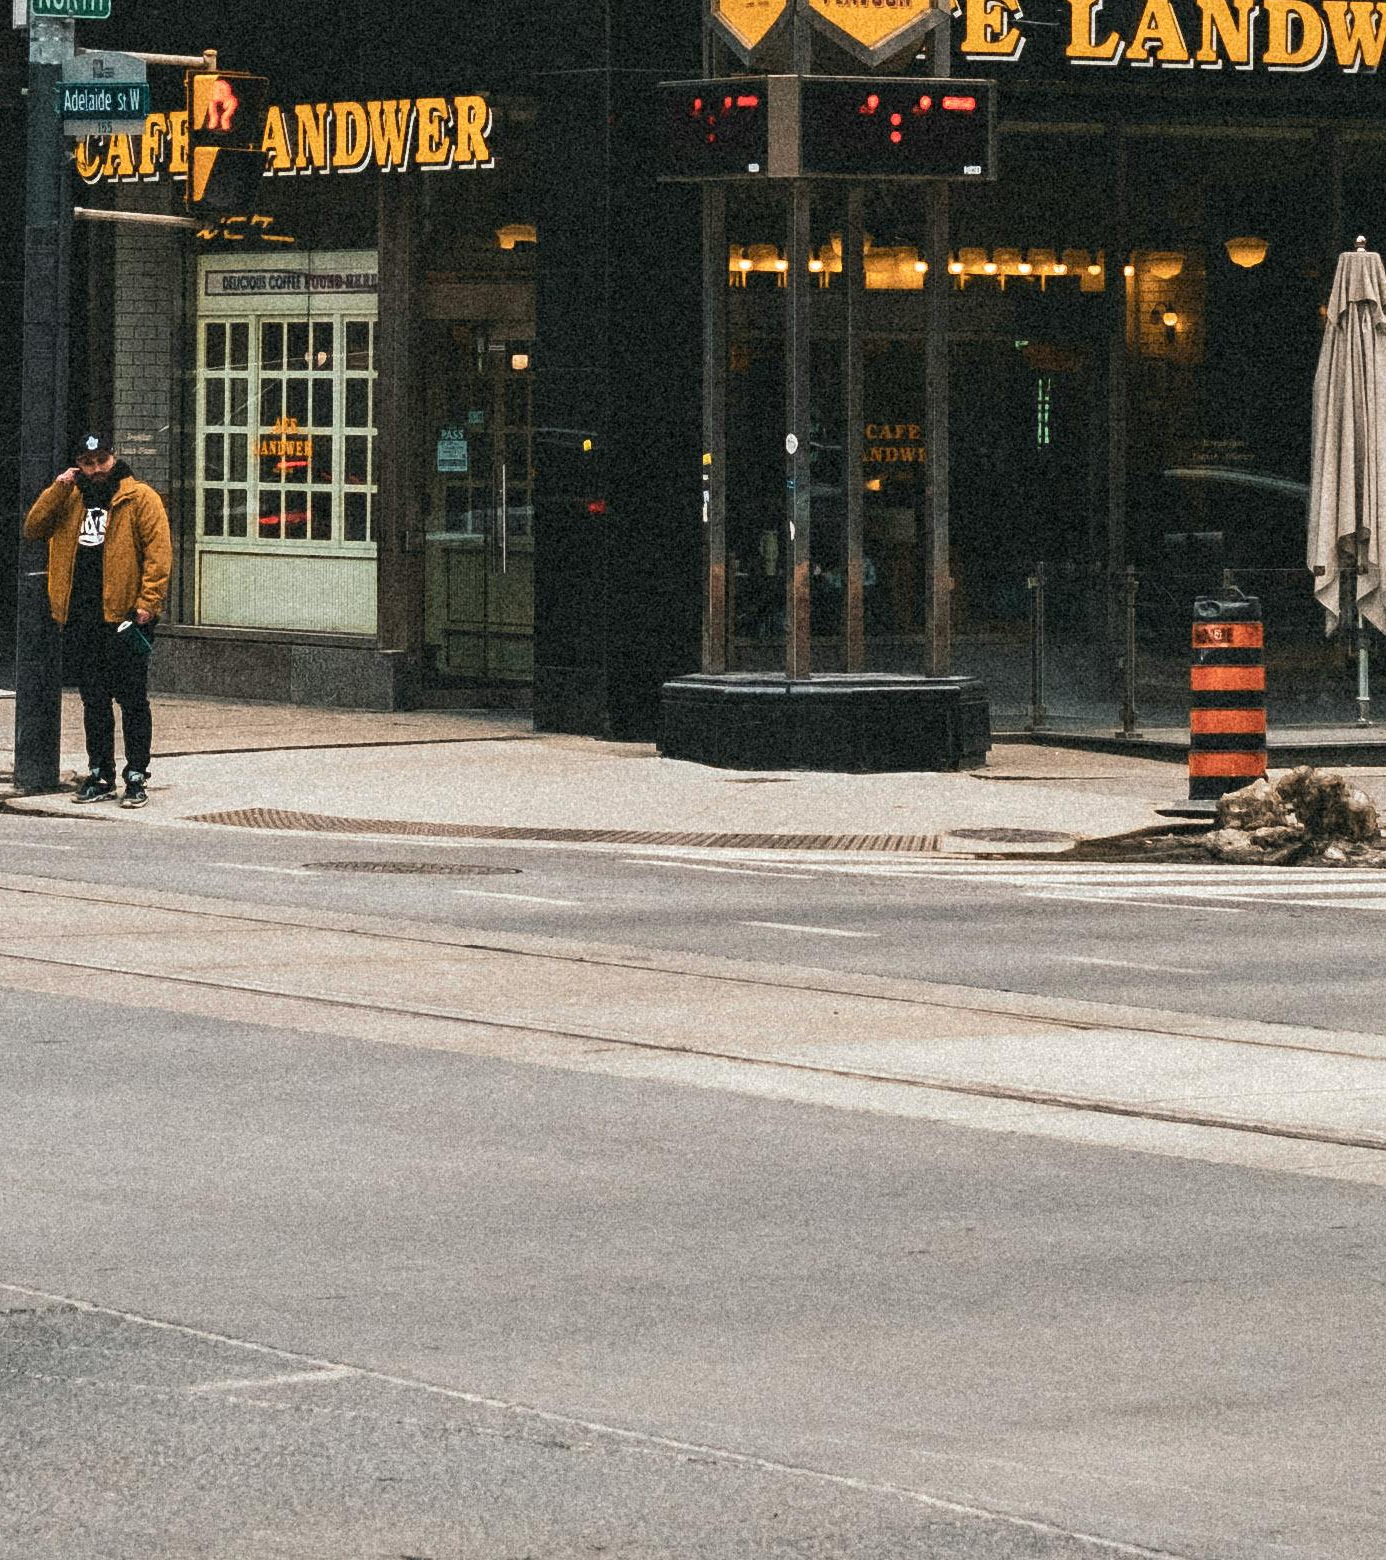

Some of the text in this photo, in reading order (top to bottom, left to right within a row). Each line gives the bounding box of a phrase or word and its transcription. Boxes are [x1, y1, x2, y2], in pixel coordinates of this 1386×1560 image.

[64, 88, 140, 111] Adelaide St W
[261, 95, 496, 177] ANDWER
